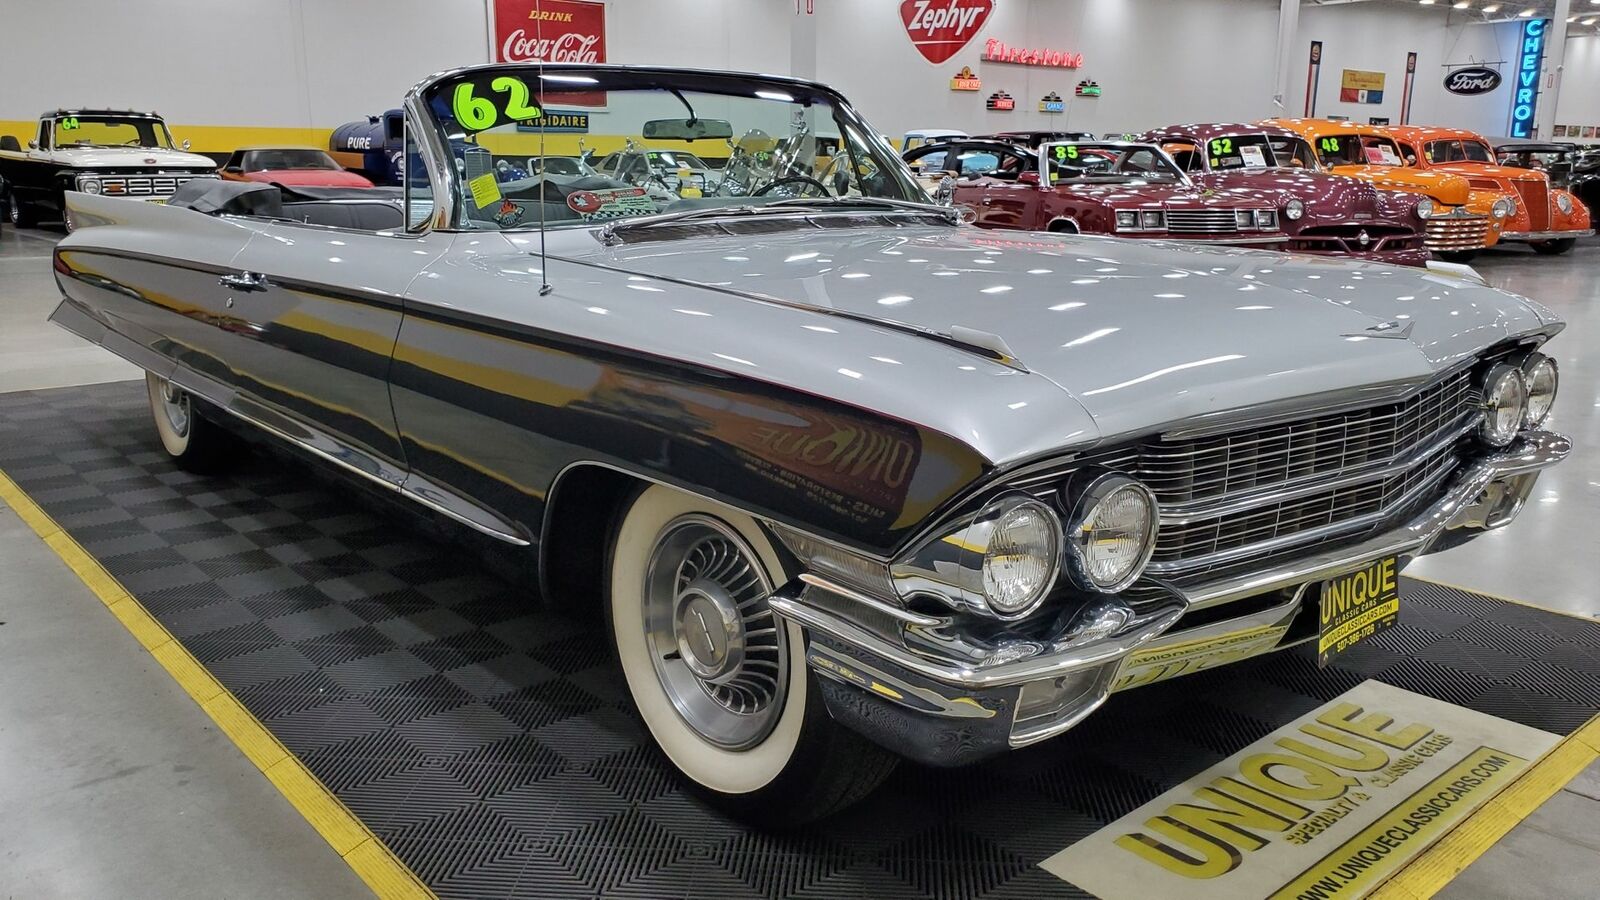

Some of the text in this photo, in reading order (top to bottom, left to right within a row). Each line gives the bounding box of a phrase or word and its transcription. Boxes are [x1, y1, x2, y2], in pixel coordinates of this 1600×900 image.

[528, 10, 573, 22] DRINK
[908, 1, 985, 36] Zephyr
[986, 38, 1084, 68] Firestone
[1449, 72, 1495, 91] Ford
[1513, 19, 1543, 137] CHEVROL
[453, 76, 541, 130] 62
[62, 117, 79, 130] 64
[519, 116, 586, 126] RIGIDAIRE
[347, 136, 371, 149] PURE
[1055, 146, 1078, 159] 85
[1211, 138, 1232, 155] 52
[1322, 138, 1339, 152] 48
[1321, 558, 1395, 624] UNIQUE
[1335, 599, 1377, 625] CLASSIC CARS
[1113, 702, 1434, 878] UNIQUE
[1283, 796, 1361, 846] SPECIALTY
[1367, 754, 1425, 788] CLASSIC
[1414, 734, 1454, 758] CARS
[1296, 755, 1512, 900] WW.UNIQUECLASSICCARS.COM
